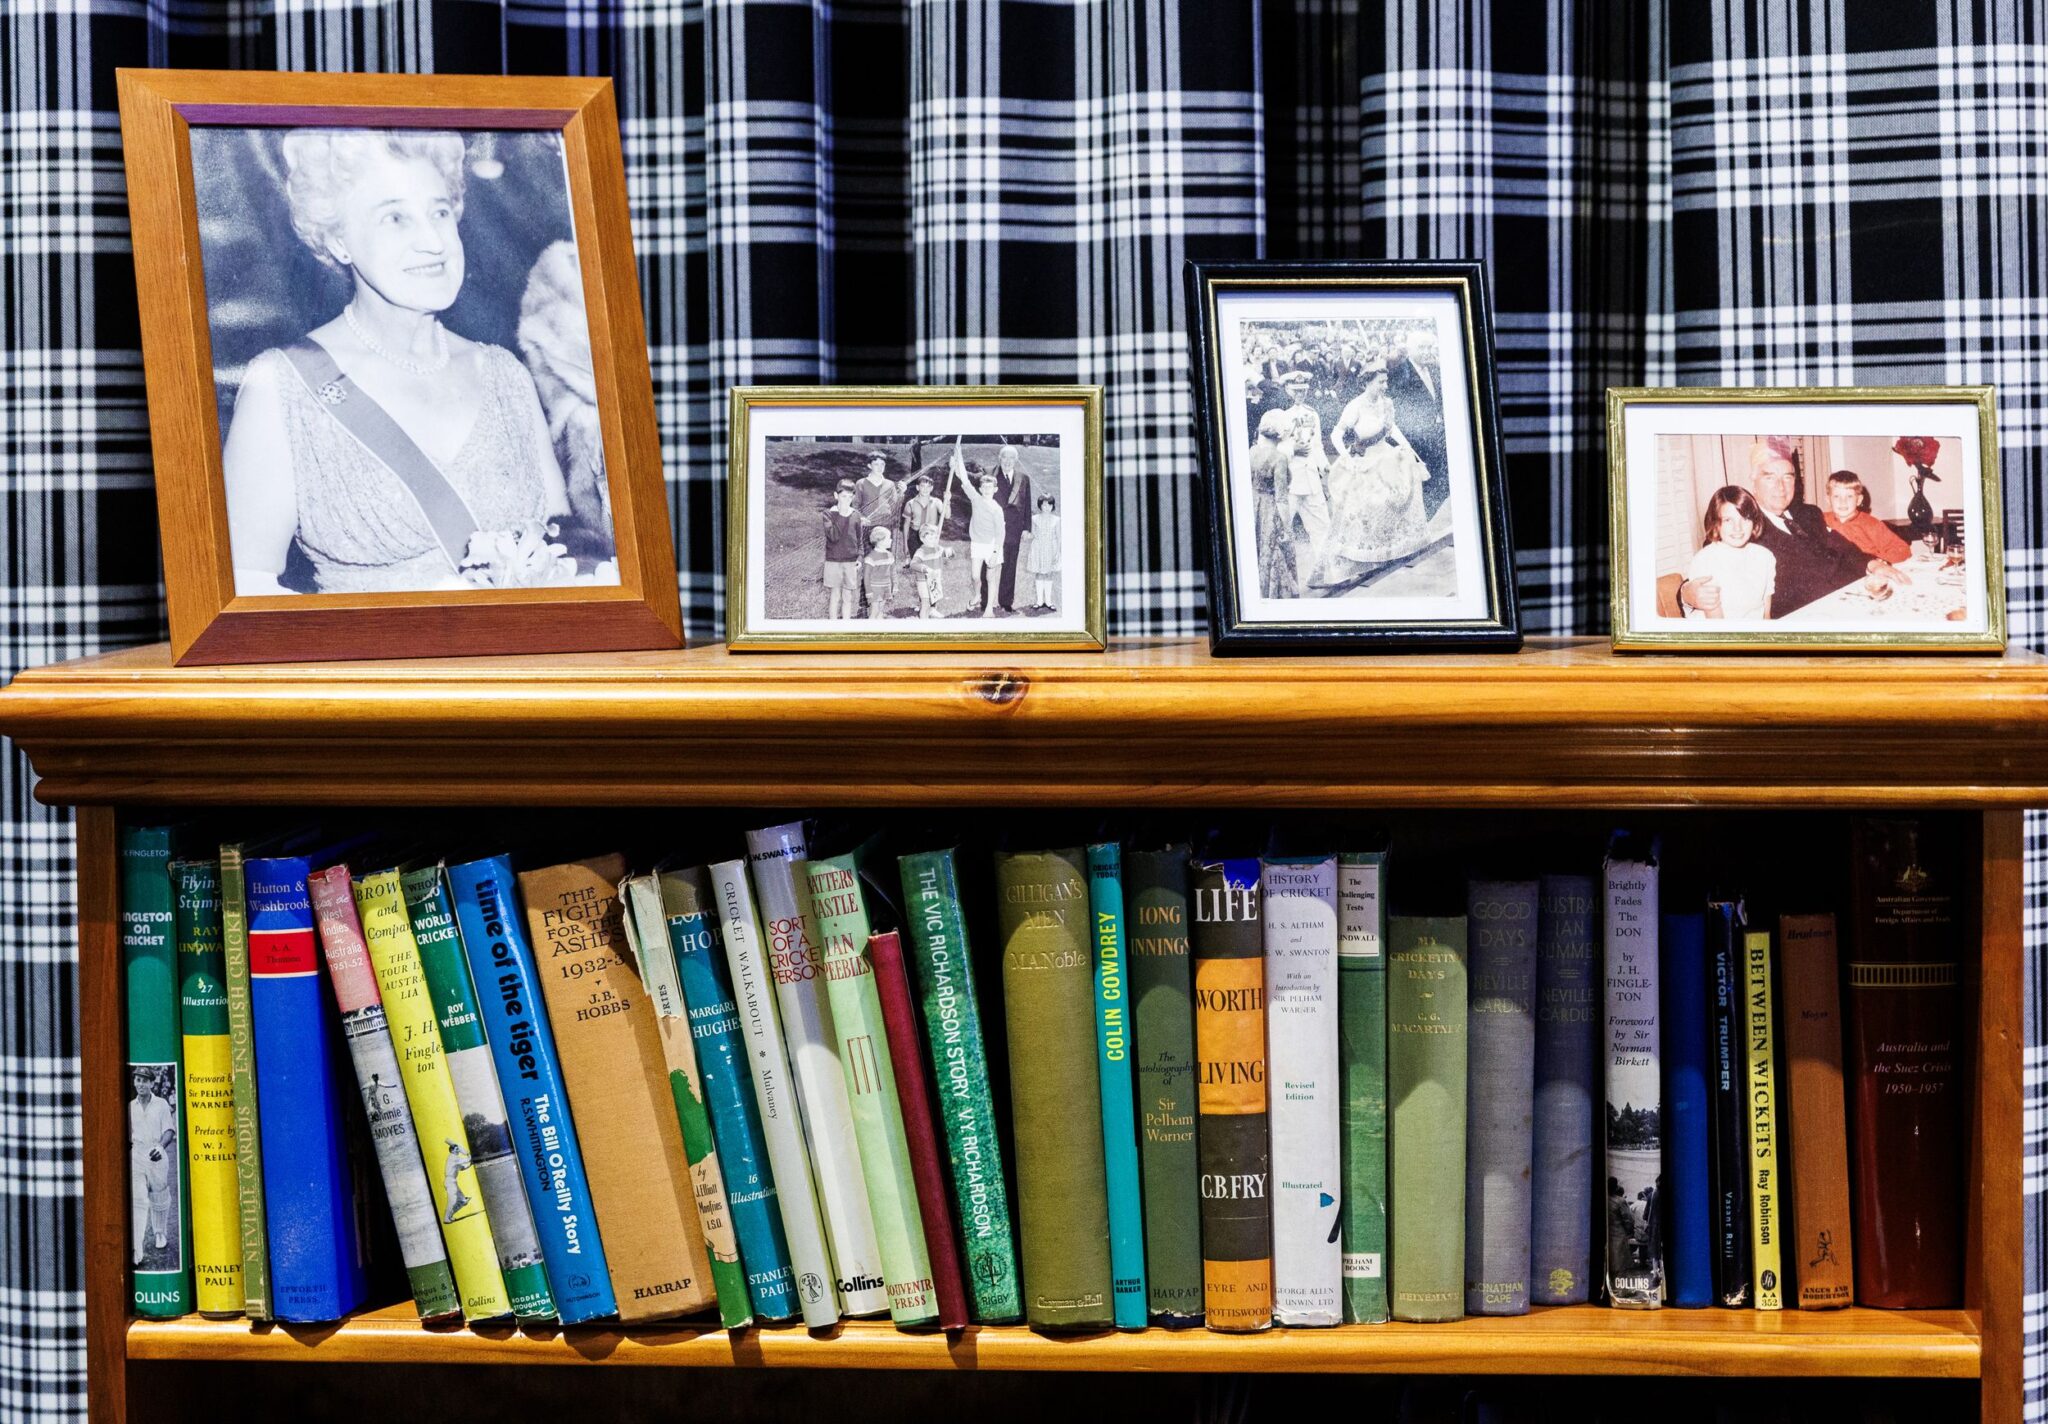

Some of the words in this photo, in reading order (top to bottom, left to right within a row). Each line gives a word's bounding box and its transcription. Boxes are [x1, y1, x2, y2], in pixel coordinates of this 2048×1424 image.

[919, 868, 938, 901] THE
[1269, 874, 1320, 884] HISTORY
[1349, 878, 1361, 886] The
[1608, 881, 1647, 892] Brightly
[253, 883, 290, 894] Hutton
[295, 882, 304, 892] &
[1007, 878, 1082, 904] GILLIGAN'S
[1263, 888, 1275, 898] OF
[1281, 887, 1331, 898] CRICKET
[1338, 891, 1375, 899] Challenging
[559, 887, 596, 906] THE
[1615, 897, 1642, 906] Fades
[250, 899, 310, 912] Washbrook
[378, 902, 399, 917] and
[425, 902, 436, 913] IN
[476, 879, 504, 937] time
[542, 897, 615, 928] FIGHT
[812, 893, 858, 920] CASTLE
[1195, 889, 1258, 922] LIFE
[1473, 902, 1532, 920] GOOD
[123, 912, 172, 921] INGLETON
[321, 910, 343, 921] West
[415, 913, 452, 929] WORLD
[925, 903, 943, 932] VIC
[1025, 910, 1065, 929] MEN
[1139, 905, 1180, 925] LONG
[1618, 912, 1637, 921] The
[134, 925, 150, 933] ON
[193, 927, 220, 936] RAY
[323, 925, 349, 936] Indies
[547, 925, 584, 941] FOR
[589, 914, 621, 931] THE
[769, 915, 807, 936] SORT
[1616, 928, 1642, 937] DON
[124, 936, 165, 945] CRICKET
[227, 899, 244, 978] CRICKET
[417, 927, 458, 945] CRICKET
[552, 927, 625, 957] ASHES
[773, 936, 795, 951] OF
[799, 933, 810, 945] A
[1480, 929, 1525, 946] DAYS
[325, 943, 362, 959] Australia
[825, 933, 855, 957] IAN
[389, 951, 412, 963] THE
[491, 942, 518, 968] of
[1098, 912, 1121, 1000] COWDREY
[1623, 952, 1634, 962] by
[381, 963, 408, 977] TOUR
[562, 953, 625, 979] 1932-3
[824, 955, 870, 981] PEEBLES
[1617, 966, 1627, 975] J.
[1628, 965, 1639, 974] H.
[773, 964, 825, 985] PERSON
[1716, 952, 1727, 1007] VICTOR
[201, 985, 213, 993] 27
[929, 935, 961, 1043] RICHARDSON
[1313, 984, 1320, 992] by
[1607, 979, 1652, 988] FINGLE-
[401, 989, 418, 1000] LIA
[498, 974, 523, 1016] the
[725, 881, 744, 943] CRICKET
[738, 952, 763, 1037] WALKABOUT
[762, 1070, 778, 1120] Mulvaney
[1196, 988, 1262, 1012] WORTH
[1616, 992, 1642, 1001] TON
[1750, 948, 1768, 1052] BETWEEN
[448, 1003, 464, 1013] ROY
[577, 999, 631, 1020] HOBBS
[1475, 998, 1529, 1013] CARDUS
[441, 1013, 477, 1028] WEBBER
[1609, 1016, 1654, 1026] Foreword
[231, 986, 248, 1073] ENGLISH
[404, 1026, 417, 1042] J.
[422, 1020, 438, 1034] H.
[1105, 1008, 1124, 1061] COLIN
[1615, 1030, 1626, 1039] by
[1634, 1029, 1650, 1038] Sir
[510, 1021, 538, 1080] tiger
[1612, 1043, 1651, 1053] Norman
[1719, 1016, 1730, 1091] TRUMPER
[1877, 1042, 1928, 1053] Australia
[1931, 1041, 1950, 1052] and
[1159, 1052, 1175, 1062] The
[1615, 1056, 1650, 1066] Birkett
[418, 1061, 434, 1073] ton
[947, 1047, 970, 1099] STORY
[1199, 1061, 1263, 1084] LIVING
[1874, 1063, 1891, 1073] the
[1894, 1063, 1919, 1073] Suez
[189, 1074, 225, 1083] Foreword
[1163, 1075, 1172, 1085] of
[535, 1094, 550, 1123] The
[1159, 1098, 1176, 1110] Sir
[1754, 1059, 1771, 1158] WICKETS
[1146, 1114, 1193, 1126] Pelham
[195, 1126, 224, 1135] Preface
[375, 1124, 405, 1139] MOYES
[1147, 1129, 1193, 1142] Warner
[238, 1106, 254, 1178] CARDUS
[542, 1126, 560, 1151] Bill
[194, 1153, 237, 1161] O'REILLY
[698, 1166, 706, 1180] by
[748, 1175, 758, 1184] 16
[1757, 1169, 1770, 1190] Ray
[549, 1154, 572, 1212] O'Reilly
[962, 1136, 992, 1238] RICHARDSON
[1282, 1181, 1323, 1189] Illustrated
[245, 1187, 258, 1261] NEVILLE
[1760, 1195, 1770, 1245] Robinson
[563, 1215, 581, 1255] Story
[198, 1265, 241, 1273] STANLEY
[205, 1278, 234, 1286] PAUL
[634, 1278, 691, 1299] HARRAP
[837, 1275, 884, 1293] Collins
[886, 1279, 933, 1296] SOUVENIR
[1207, 1284, 1236, 1293] EYRE
[1246, 1283, 1267, 1292] AND
[1615, 1277, 1649, 1290] COLLINS
[135, 1291, 180, 1303] OLLINS
[761, 1284, 792, 1298] PAUL
[1153, 1288, 1199, 1300] HARRAP
[468, 1296, 495, 1307] Collins
[895, 1295, 926, 1309] PRESS
[982, 1295, 1008, 1305] RIGBY
[1486, 1295, 1511, 1303] CAPE
